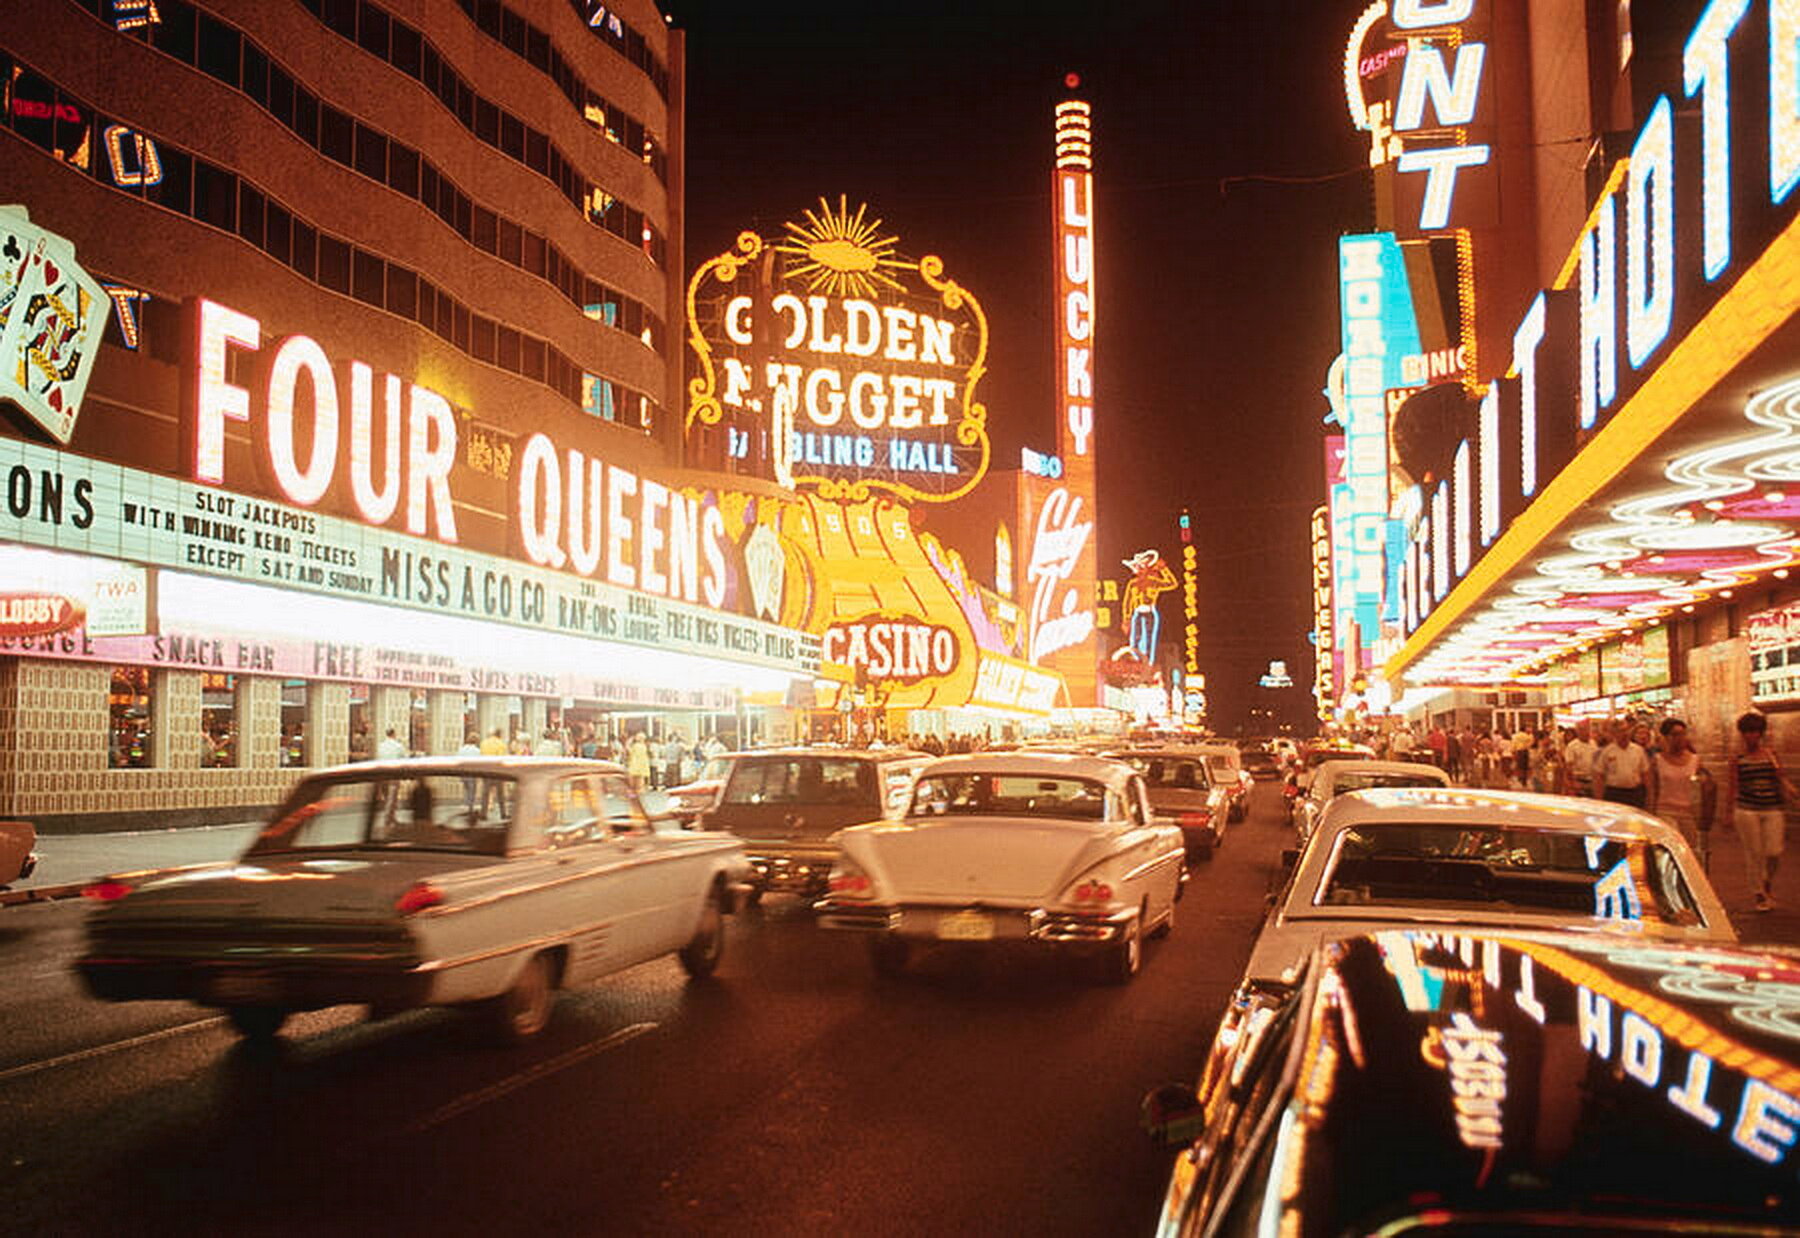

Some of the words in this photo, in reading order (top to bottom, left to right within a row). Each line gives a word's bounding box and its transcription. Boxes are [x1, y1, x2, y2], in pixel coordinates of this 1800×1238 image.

[724, 293, 956, 367] GOLDEN
[1064, 176, 1094, 456] LUCKY
[722, 358, 956, 429] NUGGET
[195, 298, 458, 543] FOUR
[518, 432, 728, 609] QUEENS
[889, 437, 959, 475] HALL
[7, 465, 95, 530] ONS
[195, 491, 236, 519] SLOT
[242, 503, 317, 535] JACKPOTS
[123, 502, 176, 530] WITH
[182, 514, 246, 546] WINNING
[253, 530, 292, 555] KENO
[301, 540, 358, 568] TICKETS
[95, 581, 137, 600] TWA
[186, 545, 244, 571] EXCEPT
[261, 556, 294, 581] SAT
[298, 564, 325, 587] AND
[328, 568, 374, 594] SUNDAY
[381, 545, 450, 607] MISS
[461, 565, 476, 611] A
[484, 571, 512, 618] GO
[521, 578, 546, 624] GO
[1, 599, 63, 623] LOBBY
[153, 635, 224, 666] SNACK
[237, 641, 275, 671] BAR
[313, 640, 365, 678] FREE
[823, 622, 954, 679] CASINO
